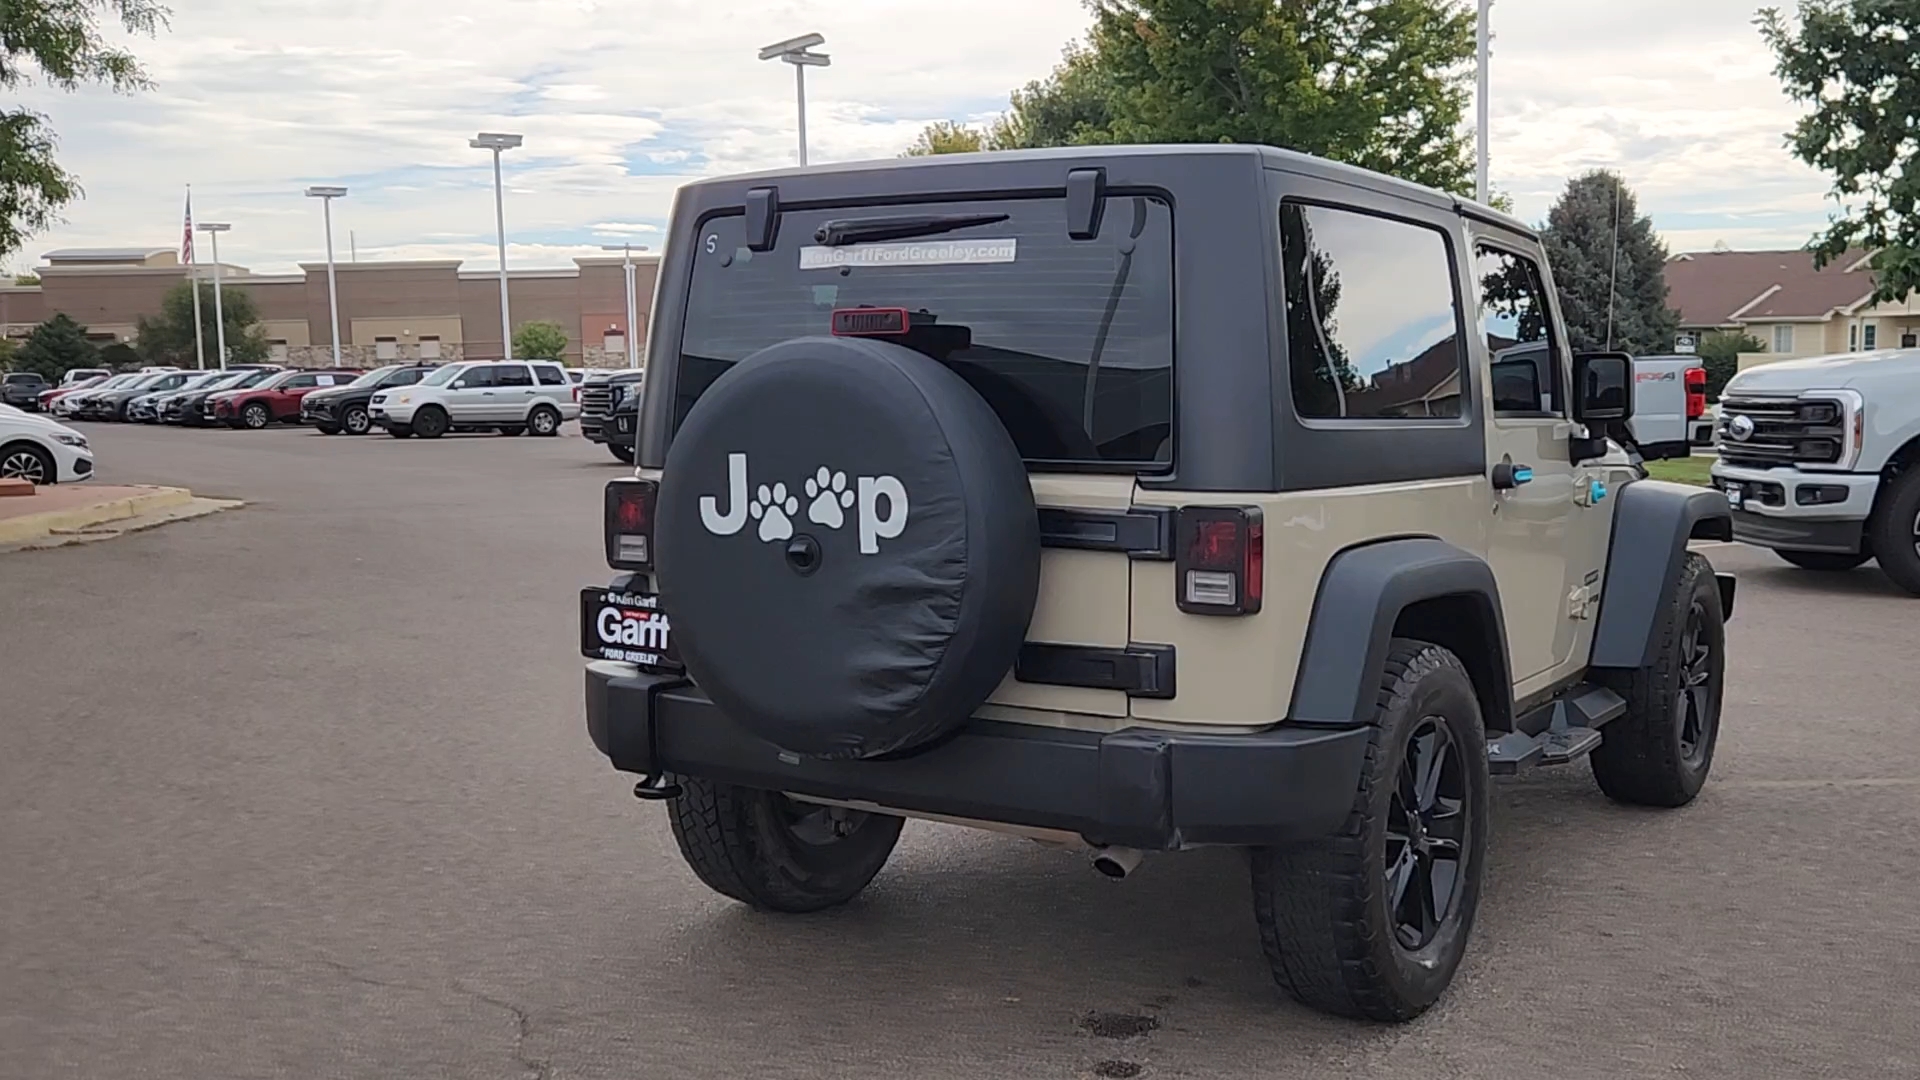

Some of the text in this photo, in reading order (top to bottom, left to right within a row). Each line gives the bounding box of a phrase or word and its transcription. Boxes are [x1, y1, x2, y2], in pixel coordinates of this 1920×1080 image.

[597, 606, 671, 650] Garff
[605, 648, 658, 664] FORD GREELEY
